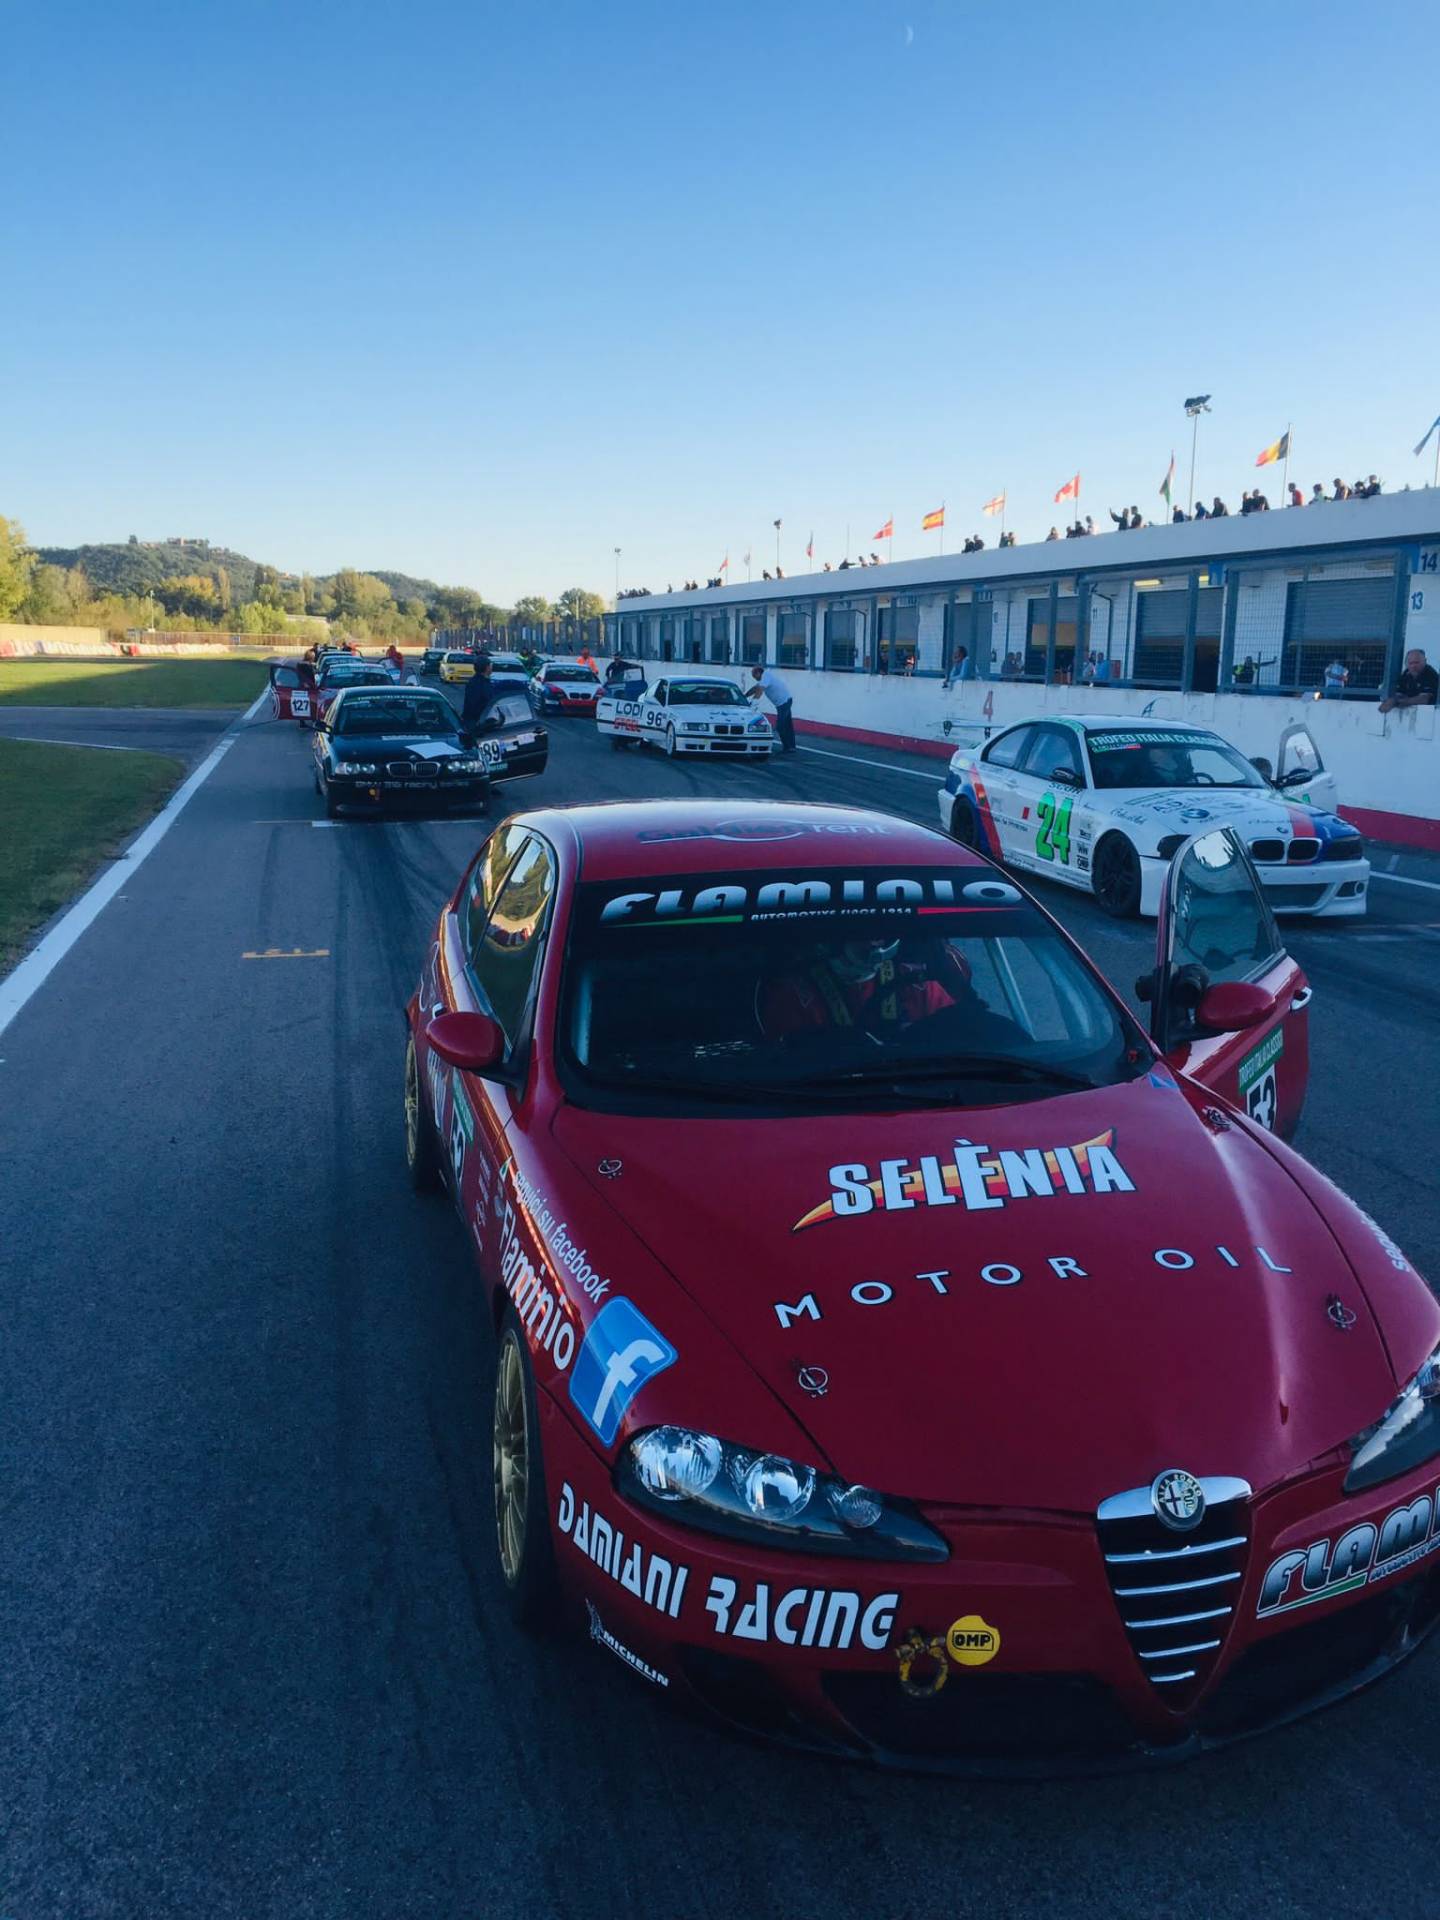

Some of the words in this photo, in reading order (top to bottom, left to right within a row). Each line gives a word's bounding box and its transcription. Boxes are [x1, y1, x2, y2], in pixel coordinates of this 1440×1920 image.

[1421, 552, 1438, 571] 14
[1411, 591, 1424, 610] 13
[292, 700, 309, 711] 127
[616, 702, 643, 717] LODI
[646, 711, 662, 726] 96
[1091, 734, 1137, 746] TROFEO
[1137, 733, 1173, 744] ITALIA
[1035, 791, 1074, 866] 24
[600, 877, 1026, 921] FLAMINIO
[751, 909, 837, 921] AUTOMOTIVE
[828, 1139, 1137, 1216] SELÈNIA
[539, 1209, 556, 1235] su
[549, 1222, 611, 1304] facebook
[499, 1200, 575, 1371] Flaminio
[774, 1256, 1089, 1329] MOTOR
[1153, 1246, 1292, 1274] OIL
[592, 1338, 666, 1427] f
[558, 1481, 689, 1619] DAMIANI
[705, 1576, 899, 1650] RACING
[603, 1630, 669, 1687] MICHELIN
[954, 1632, 992, 1648] OMP
